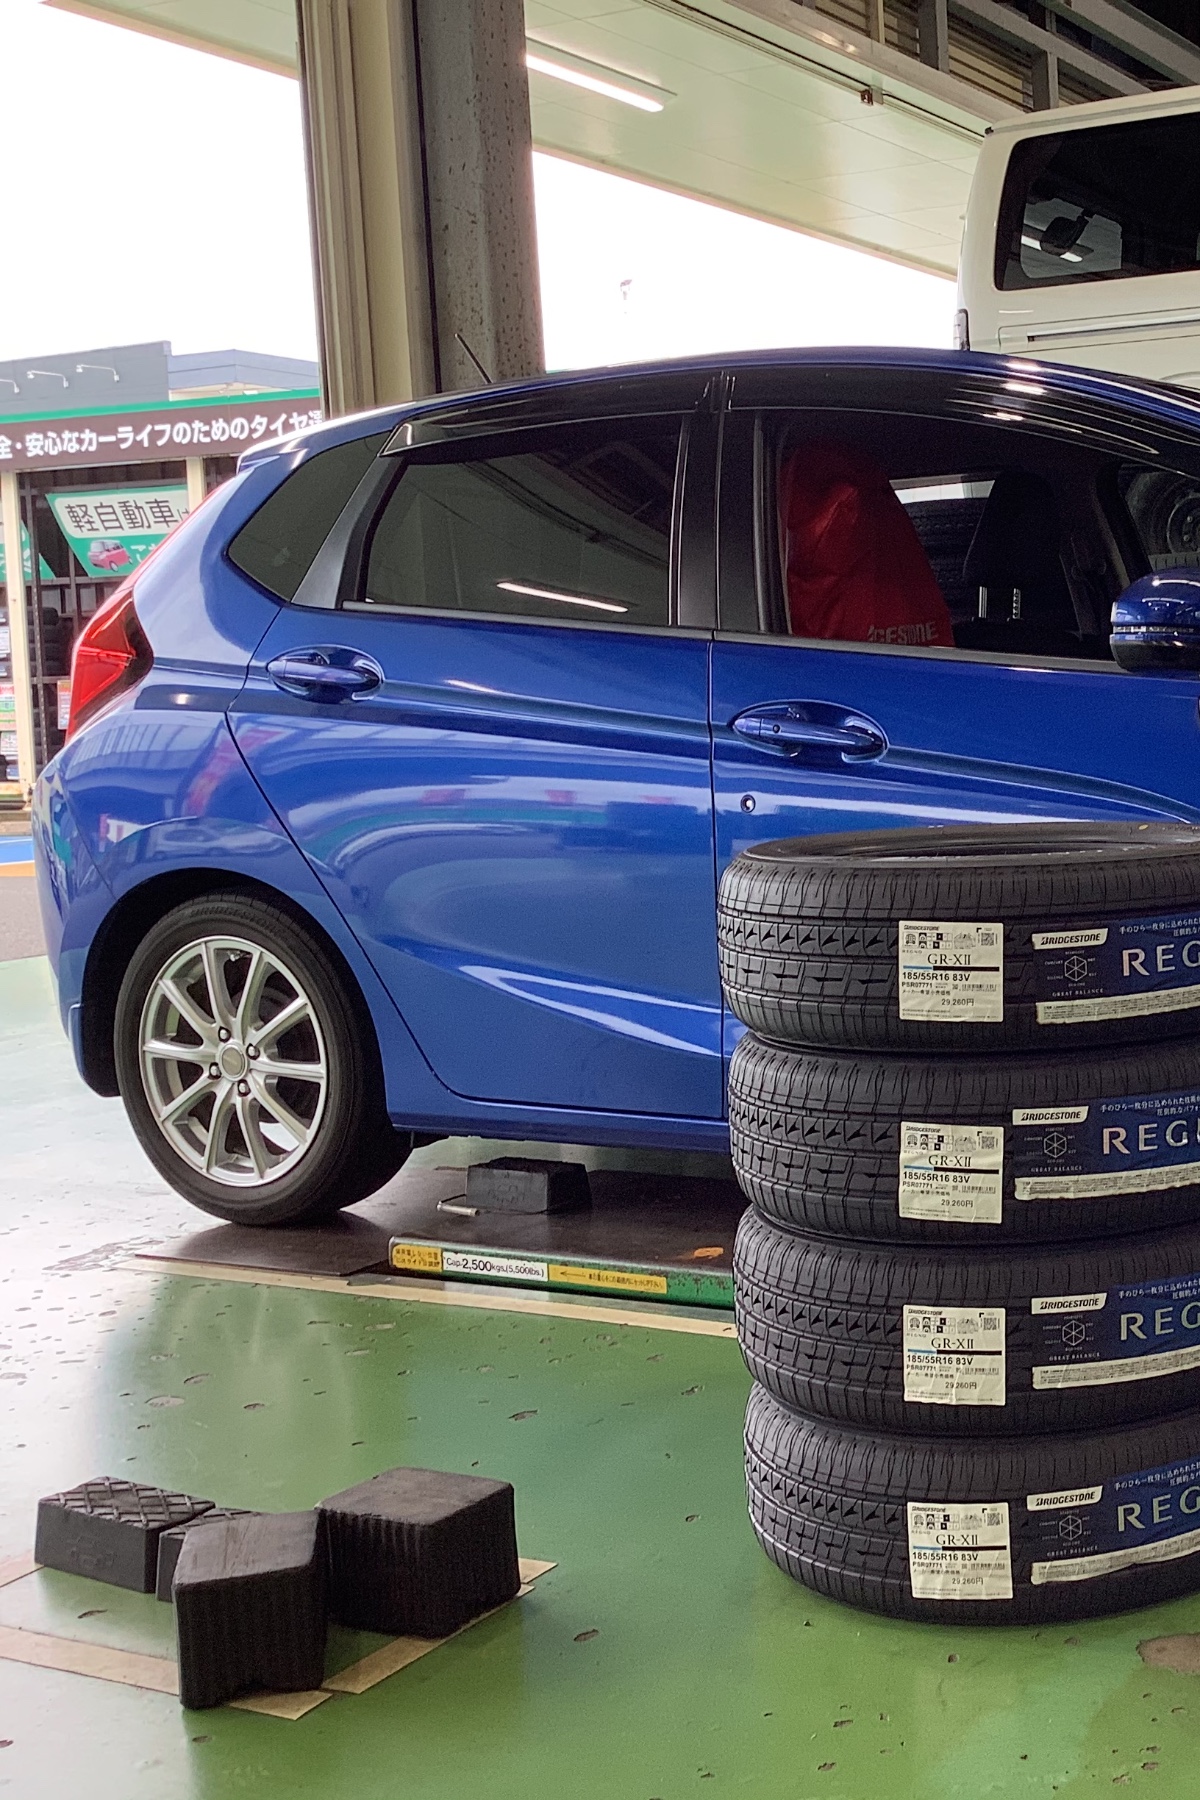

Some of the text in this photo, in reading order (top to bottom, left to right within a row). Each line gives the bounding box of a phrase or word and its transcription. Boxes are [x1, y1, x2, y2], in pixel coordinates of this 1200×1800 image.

[1040, 933, 1101, 945] BRIDGESTONE
[902, 972, 970, 981] 185/55R16 83V
[1021, 1111, 1081, 1121] BRIDGESTONE
[903, 1172, 970, 1183] 185/55R16 83V
[1040, 1298, 1099, 1310] BRIDGESTONE
[907, 1355, 973, 1365] 185/55R16 83V
[1035, 1491, 1096, 1506] BRIDGESTONE
[913, 1552, 978, 1561] 185/55R16 83V
